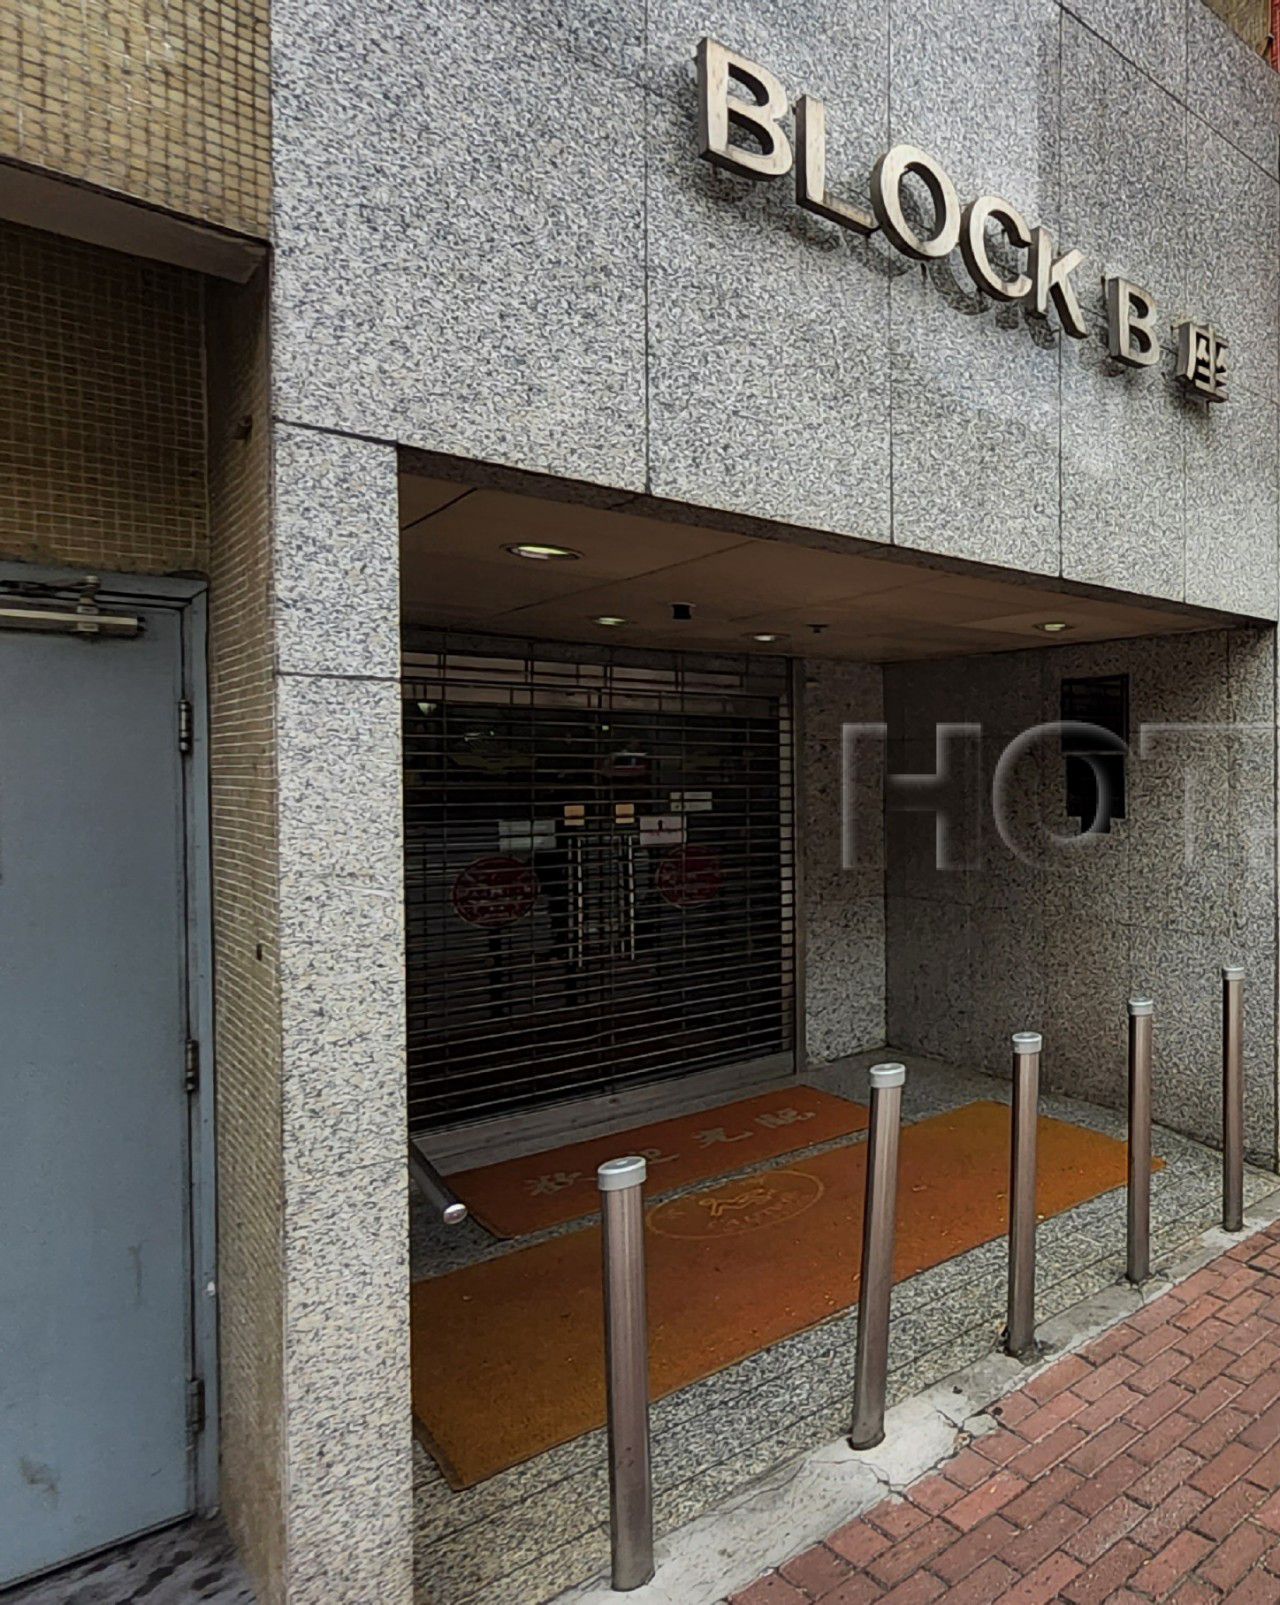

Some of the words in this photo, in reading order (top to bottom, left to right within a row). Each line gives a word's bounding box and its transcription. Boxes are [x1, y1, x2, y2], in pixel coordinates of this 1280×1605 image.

[698, 37, 1088, 339] BLOCK
[1109, 277, 1160, 368] B
[1176, 321, 1230, 404] 座
